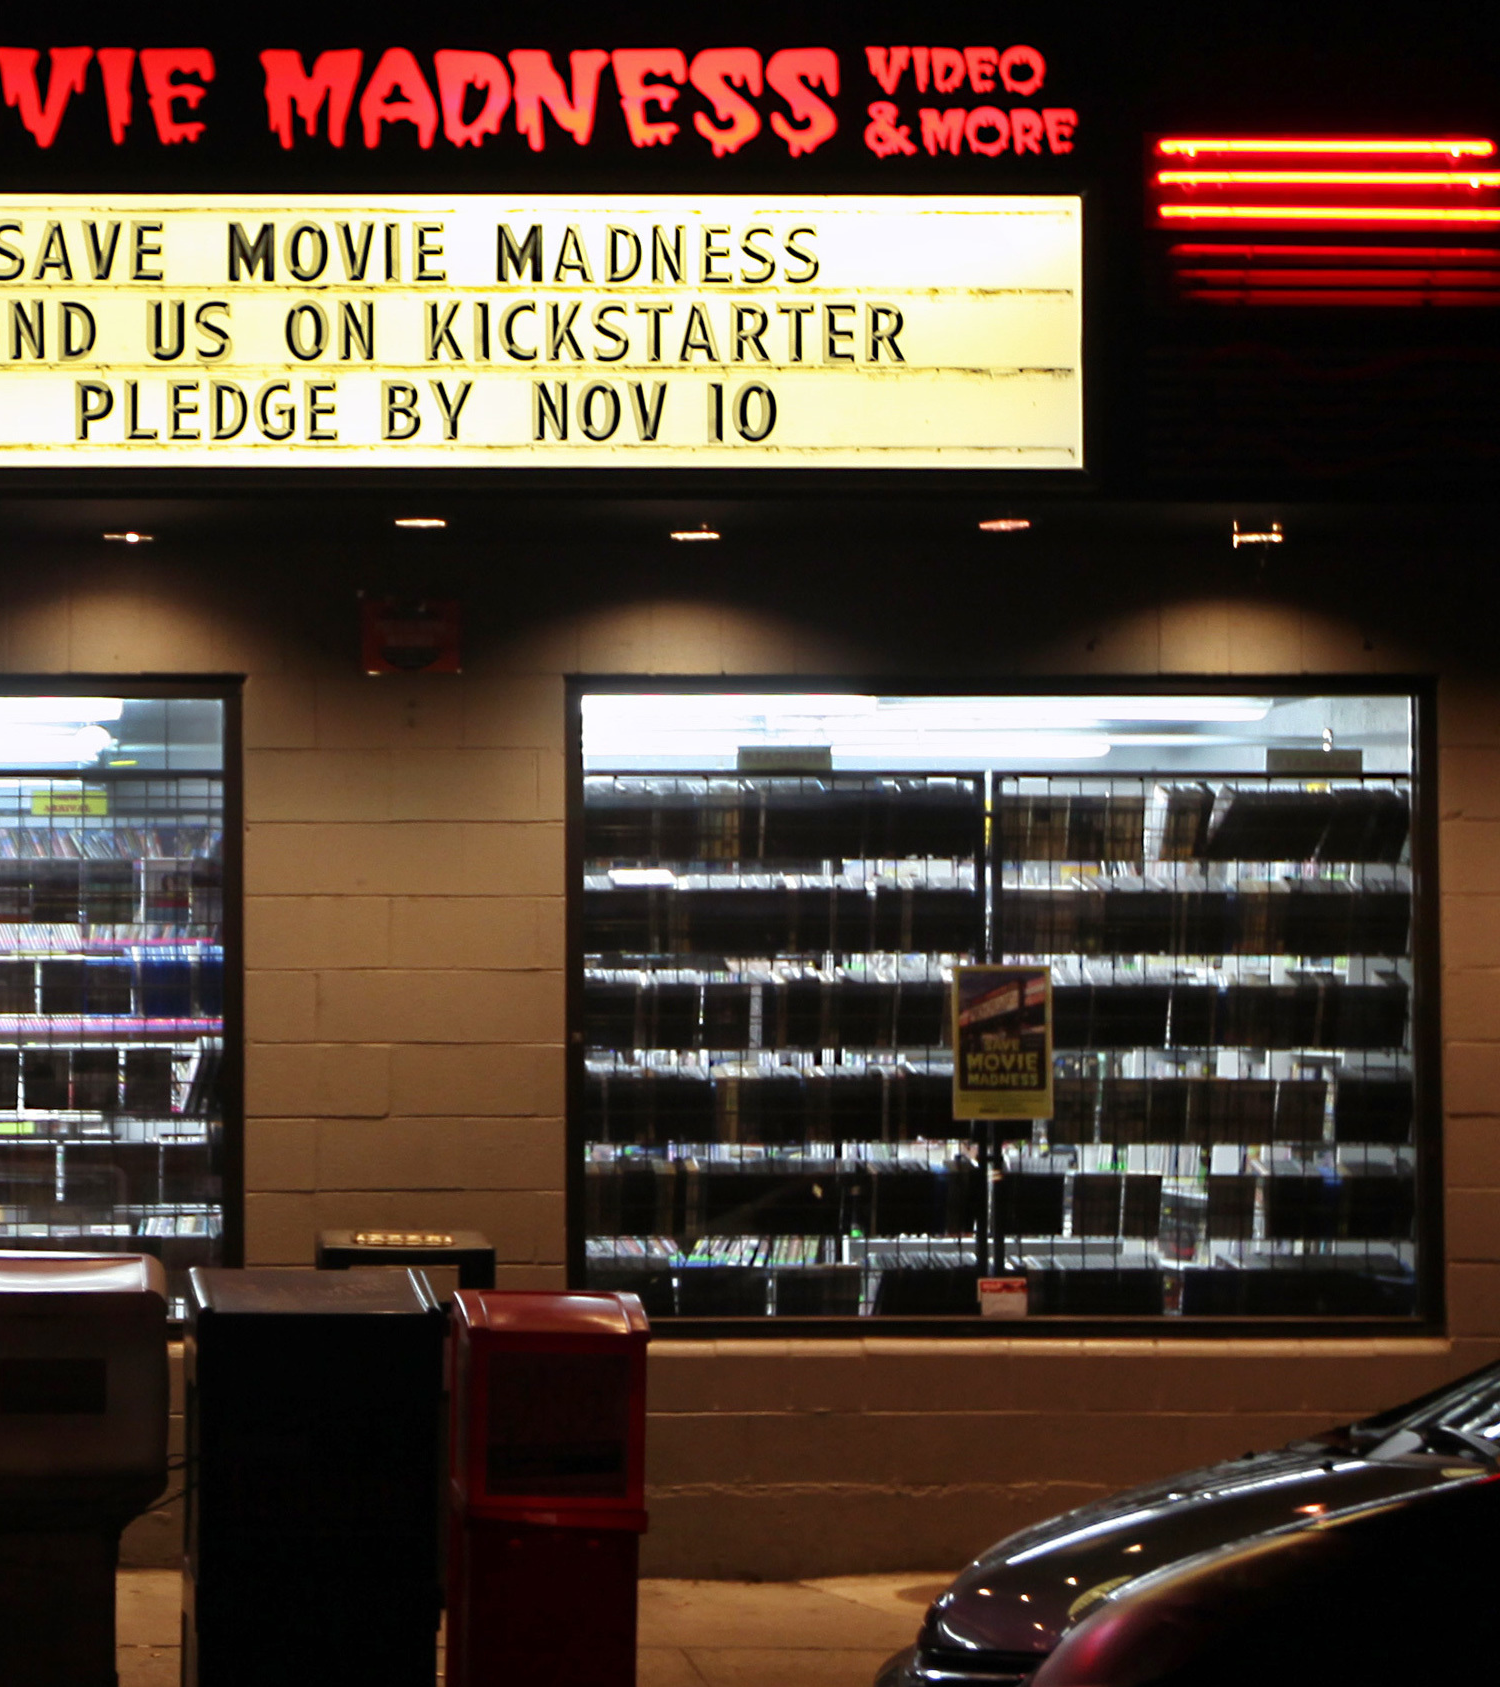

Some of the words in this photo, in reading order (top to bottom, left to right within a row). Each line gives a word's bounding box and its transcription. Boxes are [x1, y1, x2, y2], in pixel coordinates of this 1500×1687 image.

[260, 47, 841, 157] MADNESS
[864, 44, 1047, 97] VIDEO
[227, 222, 446, 284] MOVIE
[495, 224, 822, 285] MADNESS
[148, 300, 231, 363] US
[286, 301, 375, 363] ON
[426, 302, 906, 365] KICKSTARTER
[76, 380, 339, 443] PLEDGE
[384, 380, 474, 443] BY
[534, 382, 668, 444] NOV
[966, 1052, 1039, 1072] MOVIE
[967, 1072, 1039, 1087] MADNESS
